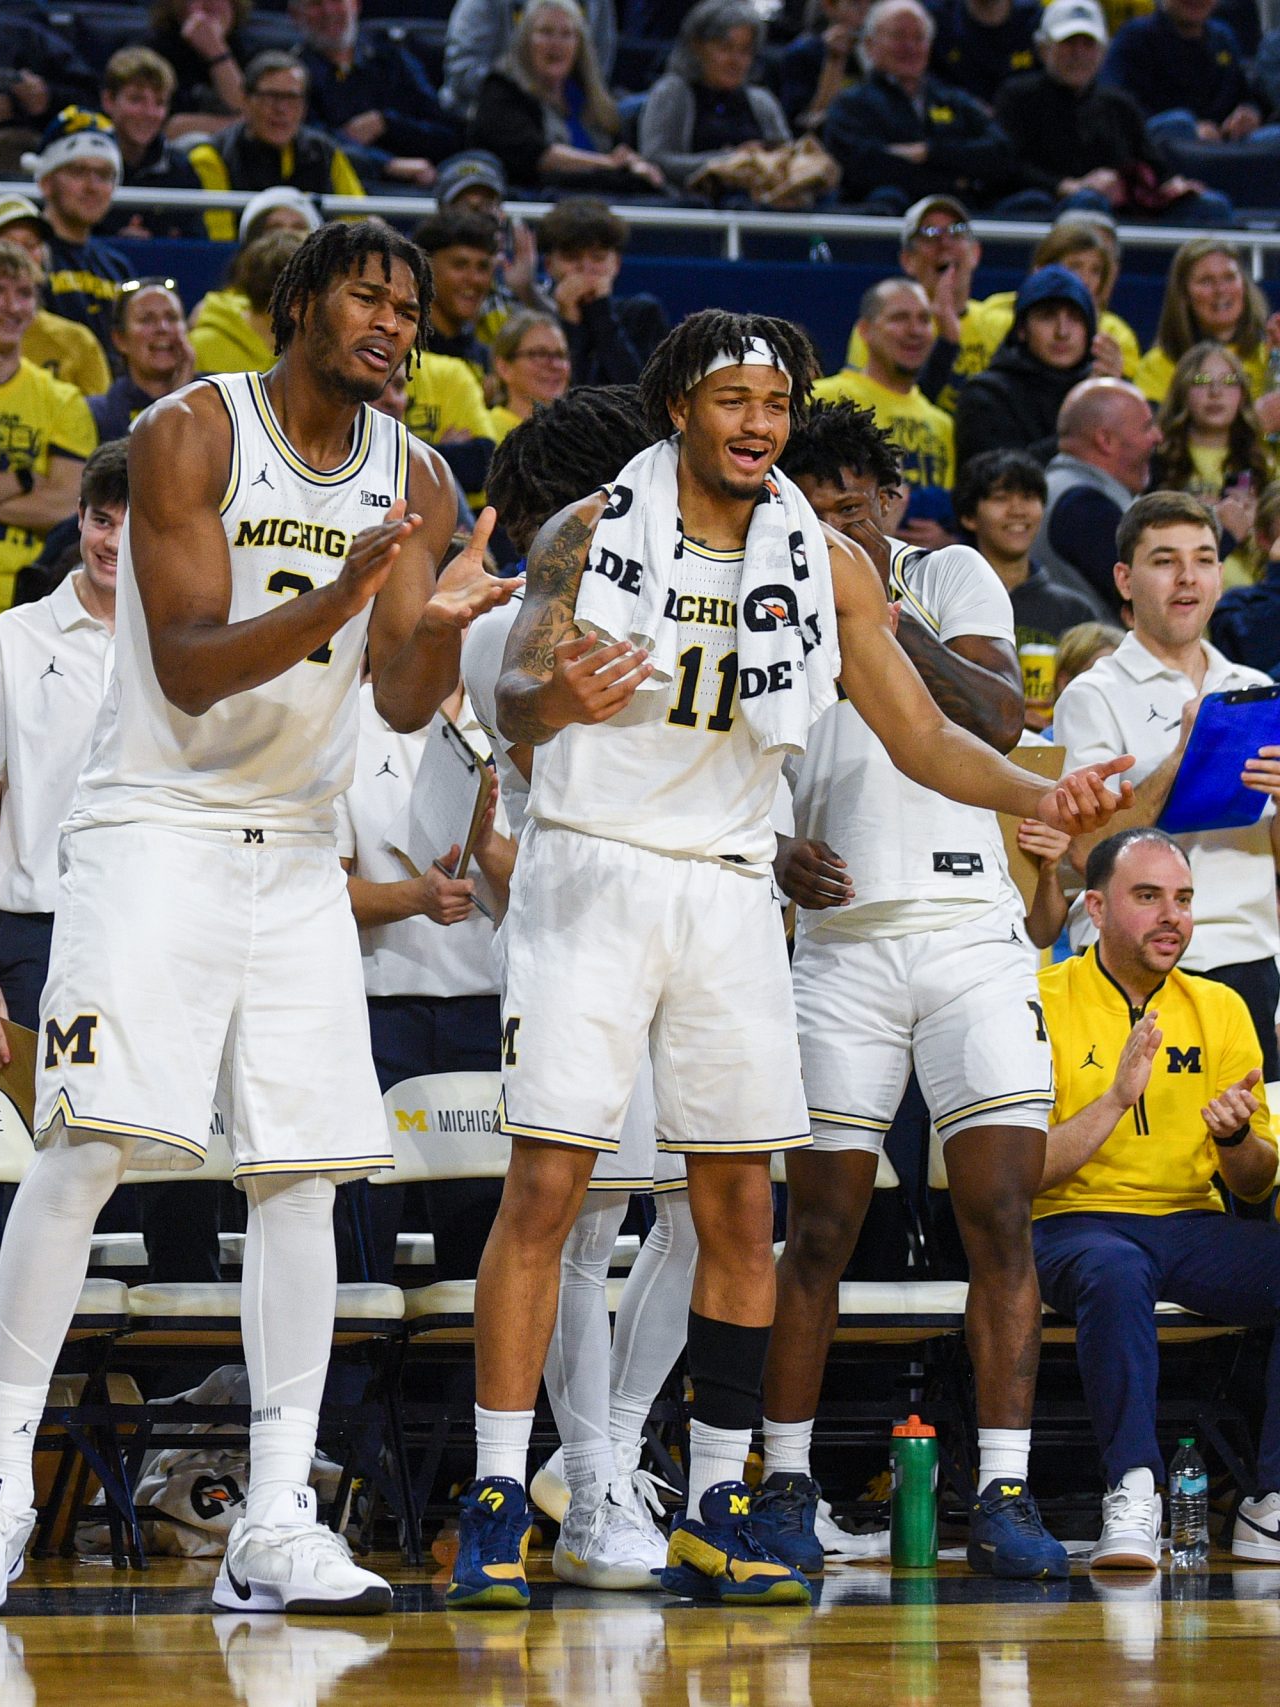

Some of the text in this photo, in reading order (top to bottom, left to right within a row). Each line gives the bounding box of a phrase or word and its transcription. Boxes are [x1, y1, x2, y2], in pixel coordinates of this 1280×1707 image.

[233, 517, 359, 561] MICHIG
[666, 643, 738, 733] 11
[241, 828, 266, 844] M
[44, 1013, 99, 1071] M
[1166, 1046, 1202, 1074] M
[394, 1109, 429, 1132] M
[728, 1494, 751, 1516] M
